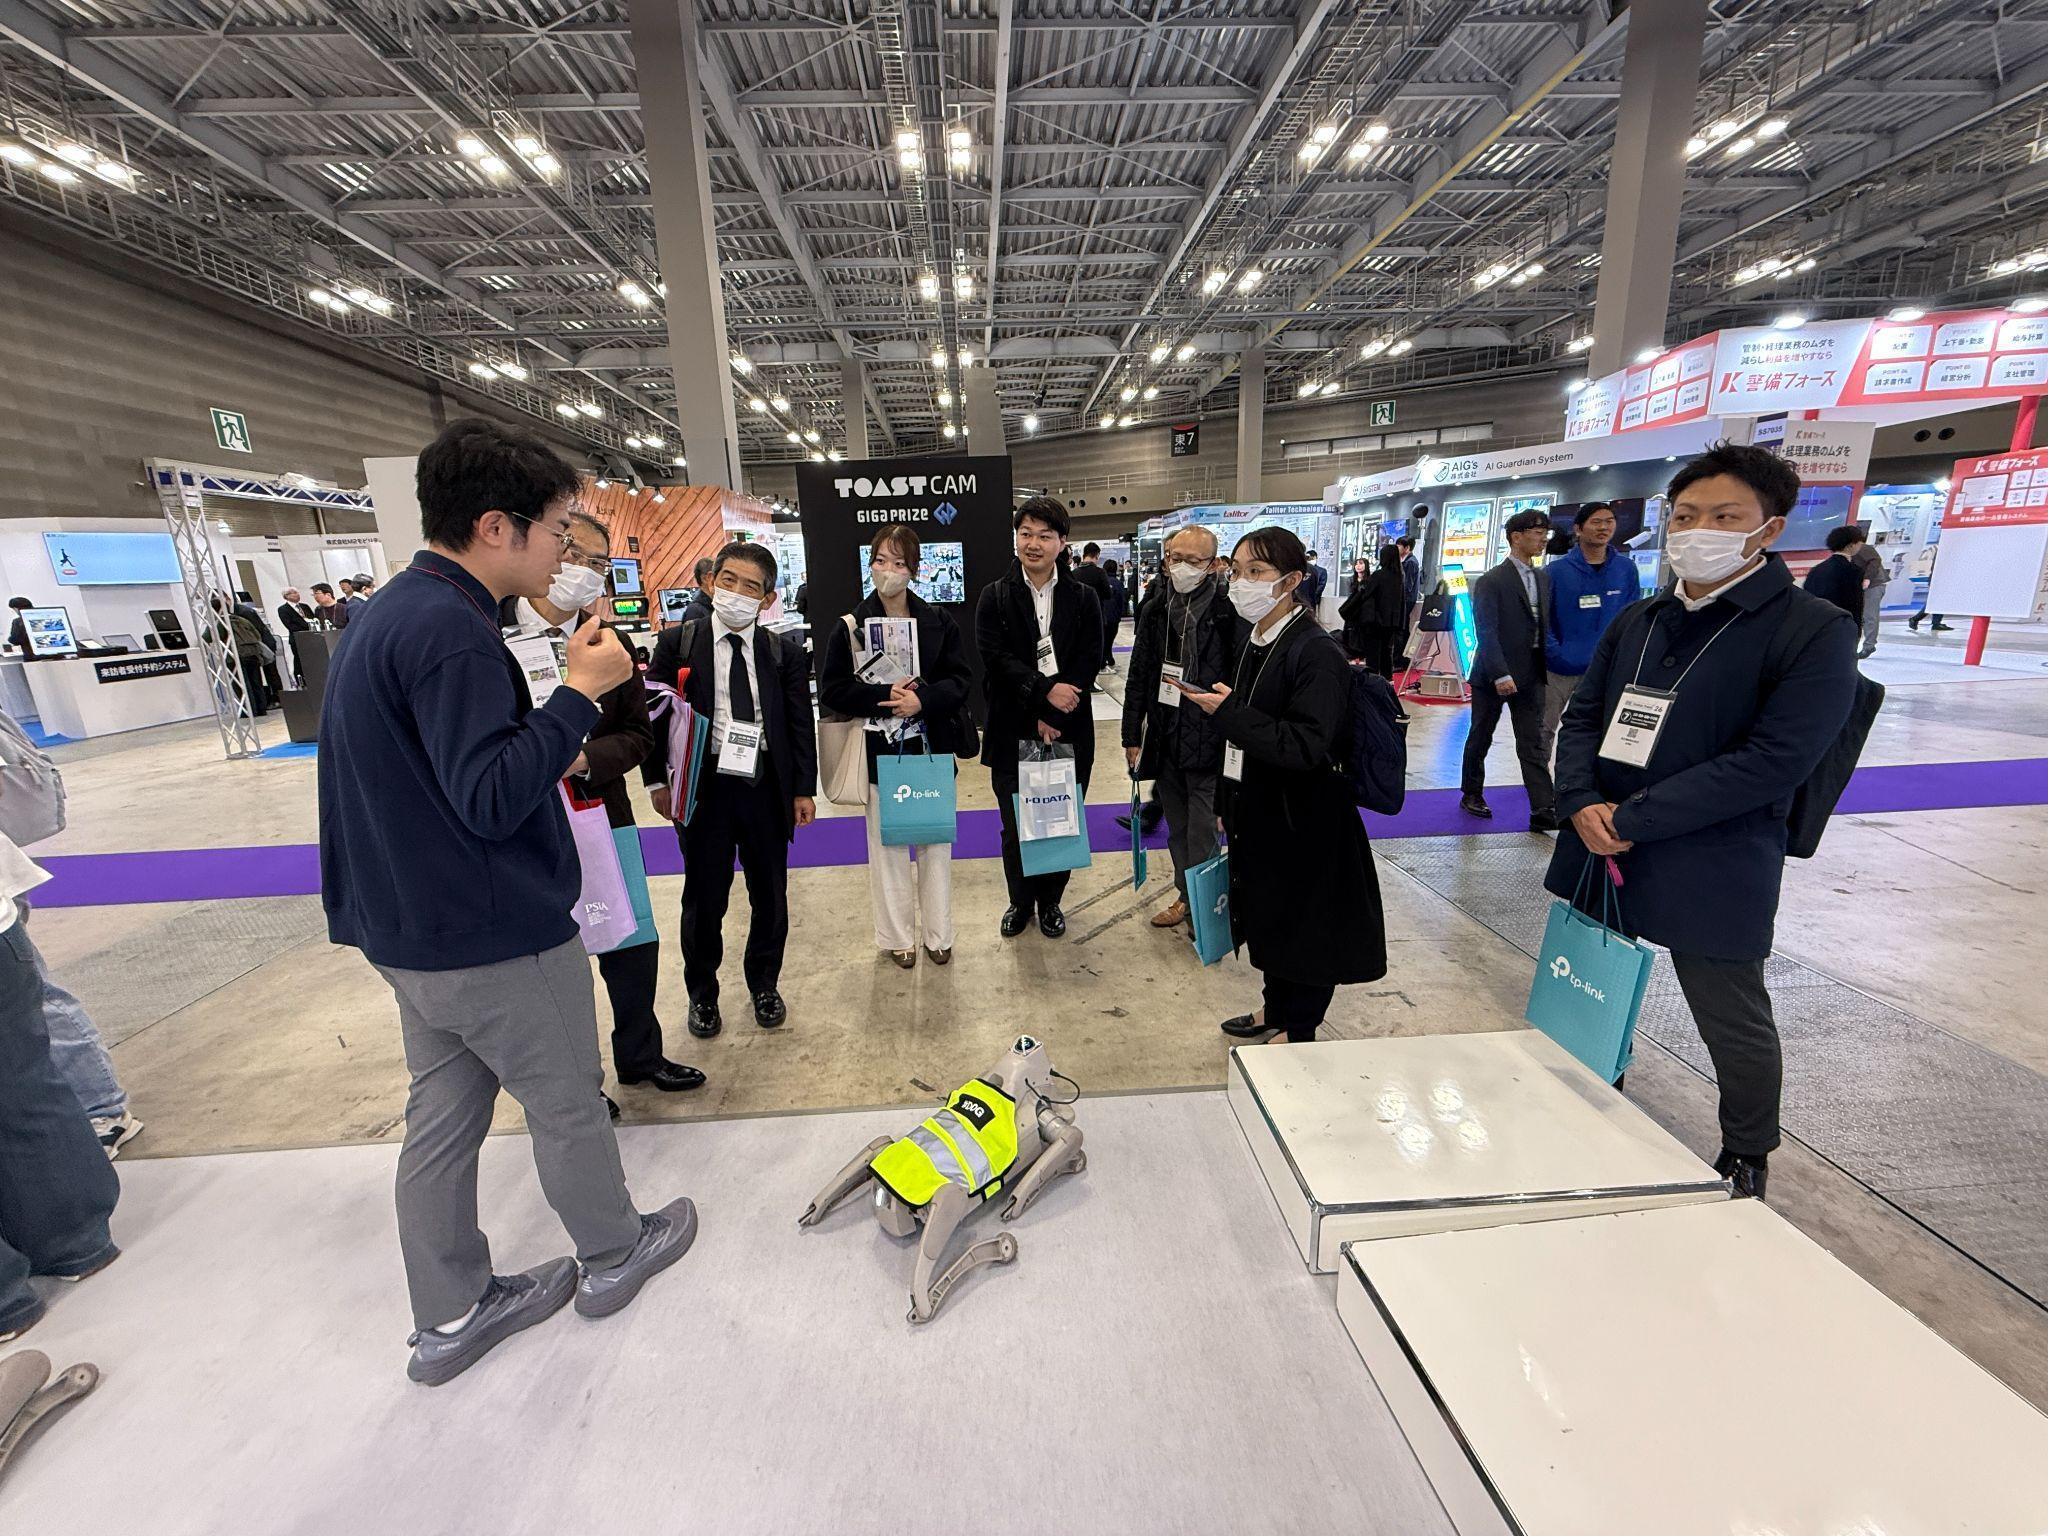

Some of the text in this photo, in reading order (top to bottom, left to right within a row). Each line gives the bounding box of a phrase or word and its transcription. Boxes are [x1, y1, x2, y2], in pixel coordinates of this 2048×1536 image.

[1742, 338, 1835, 353] 管制・経理業務のムダを
[1740, 350, 1833, 366] 減らし利益を増やすなら
[1746, 370, 1838, 392] 警備フォース
[1451, 460, 1478, 472] AIG's
[1496, 458, 1536, 469] Guardian
[1538, 453, 1574, 465] System
[834, 474, 977, 498] TOAST CAM
[1288, 504, 1324, 513] Technology
[100, 659, 187, 678] 来訪者受付予約システム
[912, 790, 941, 799] tp-link
[1042, 794, 1071, 804] DATA
[1570, 972, 1606, 1004] tp-link
